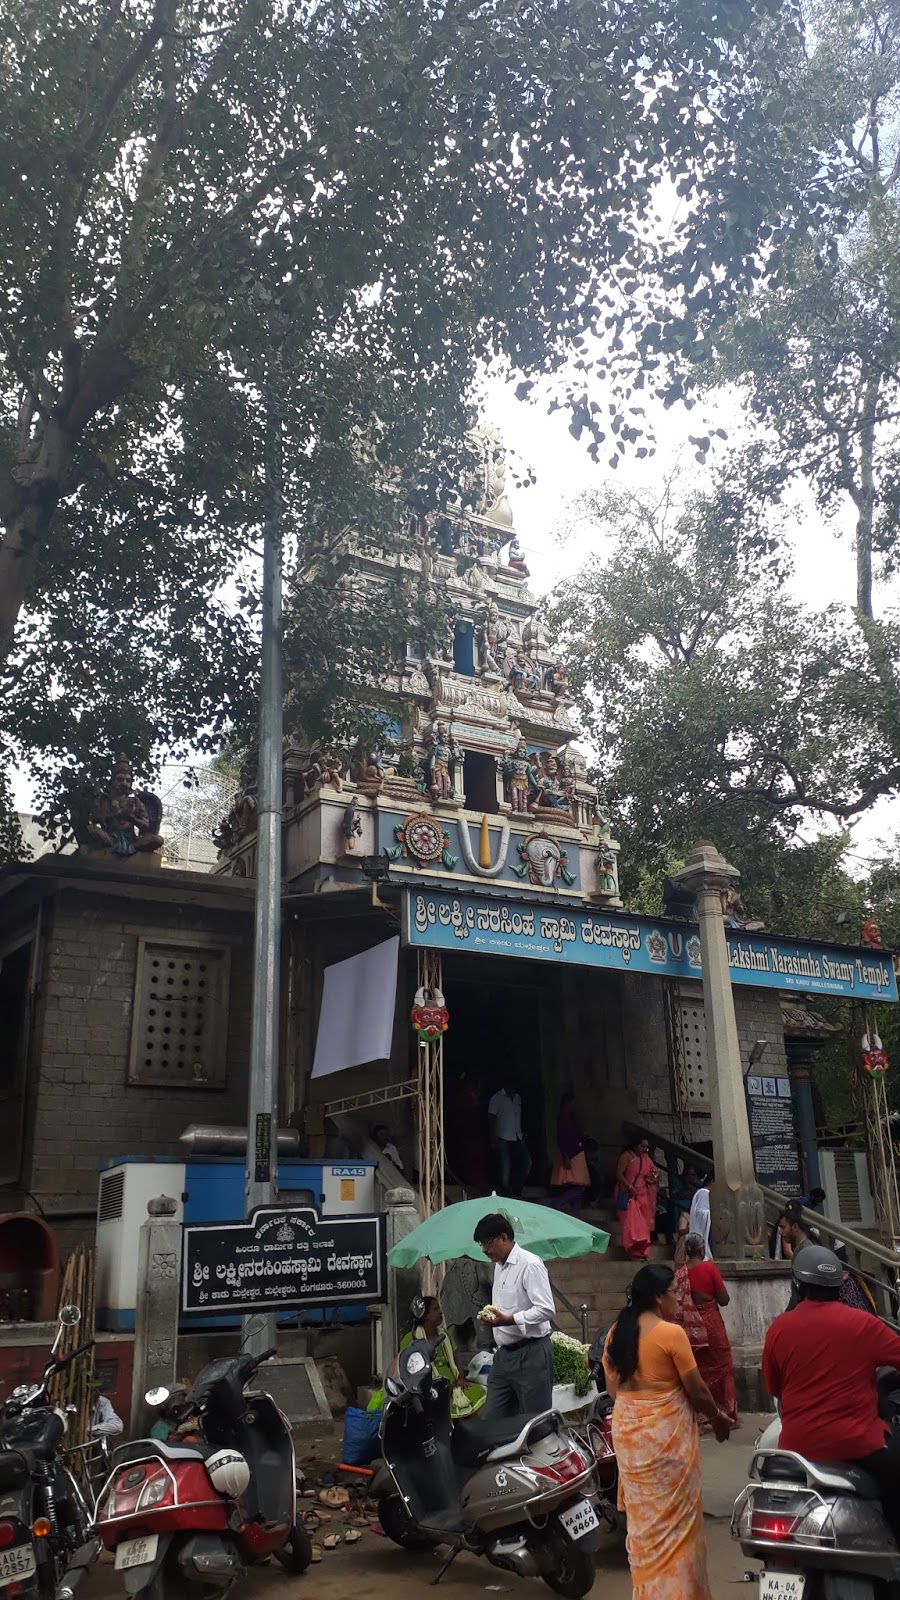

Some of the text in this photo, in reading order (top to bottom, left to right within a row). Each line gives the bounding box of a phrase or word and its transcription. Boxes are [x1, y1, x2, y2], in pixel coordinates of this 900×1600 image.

[415, 895, 436, 932] ಶ್ರೀ
[540, 917, 577, 953] ಸ್ವಾಮಿ
[581, 917, 641, 964] ದೇವಸ್ಥಾನ
[726, 942, 890, 992] Lakshmi Narasimha Swamy Temple
[332, 1168, 365, 1176] RA45
[192, 1262, 210, 1287] ಶ್ರೀ
[327, 1250, 374, 1278] ದೇವಸ್ಥಾನ
[0, 1550, 23, 1567] A04
